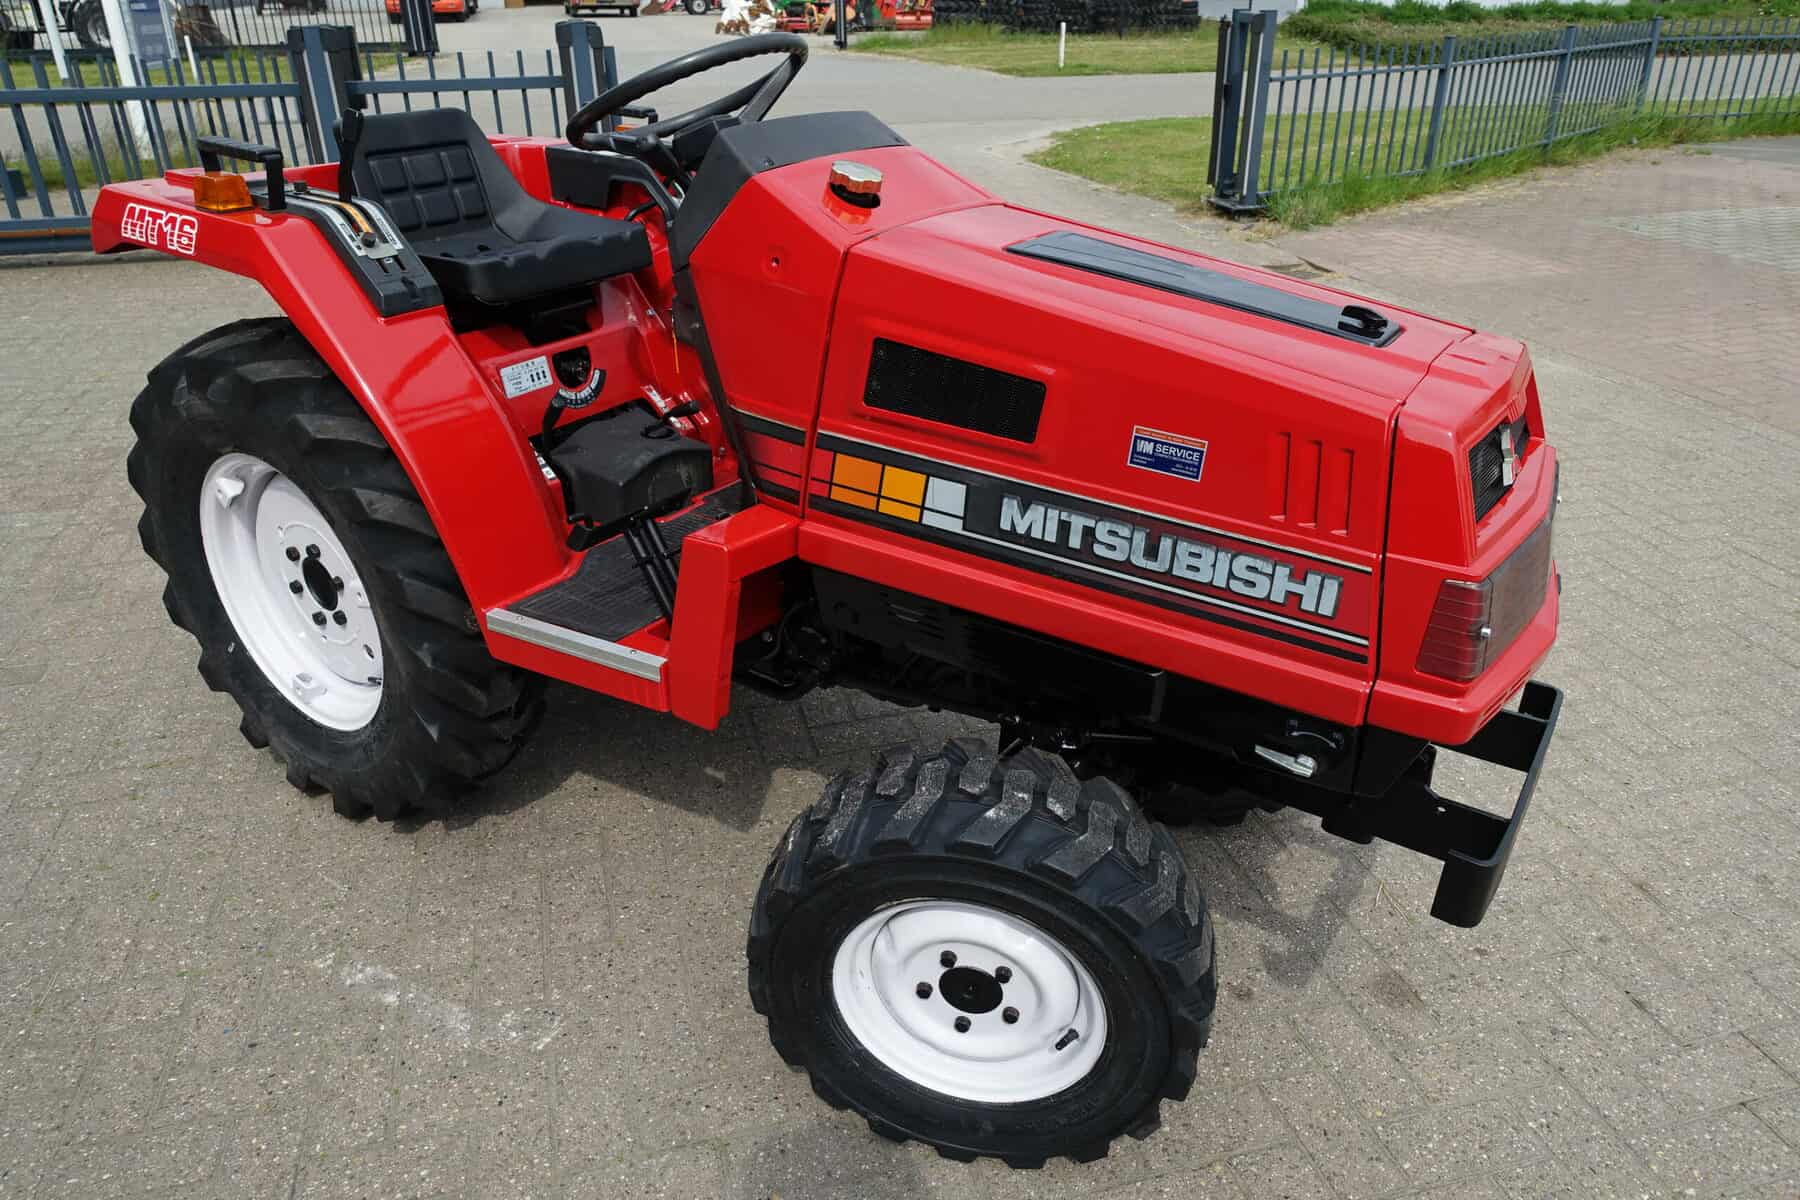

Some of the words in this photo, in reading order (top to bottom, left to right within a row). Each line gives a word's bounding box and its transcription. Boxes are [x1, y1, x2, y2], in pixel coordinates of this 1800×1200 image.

[121, 203, 198, 255] MT16
[1155, 443, 1200, 462] SERVICE
[999, 496, 1342, 617] MITSUBISHI
